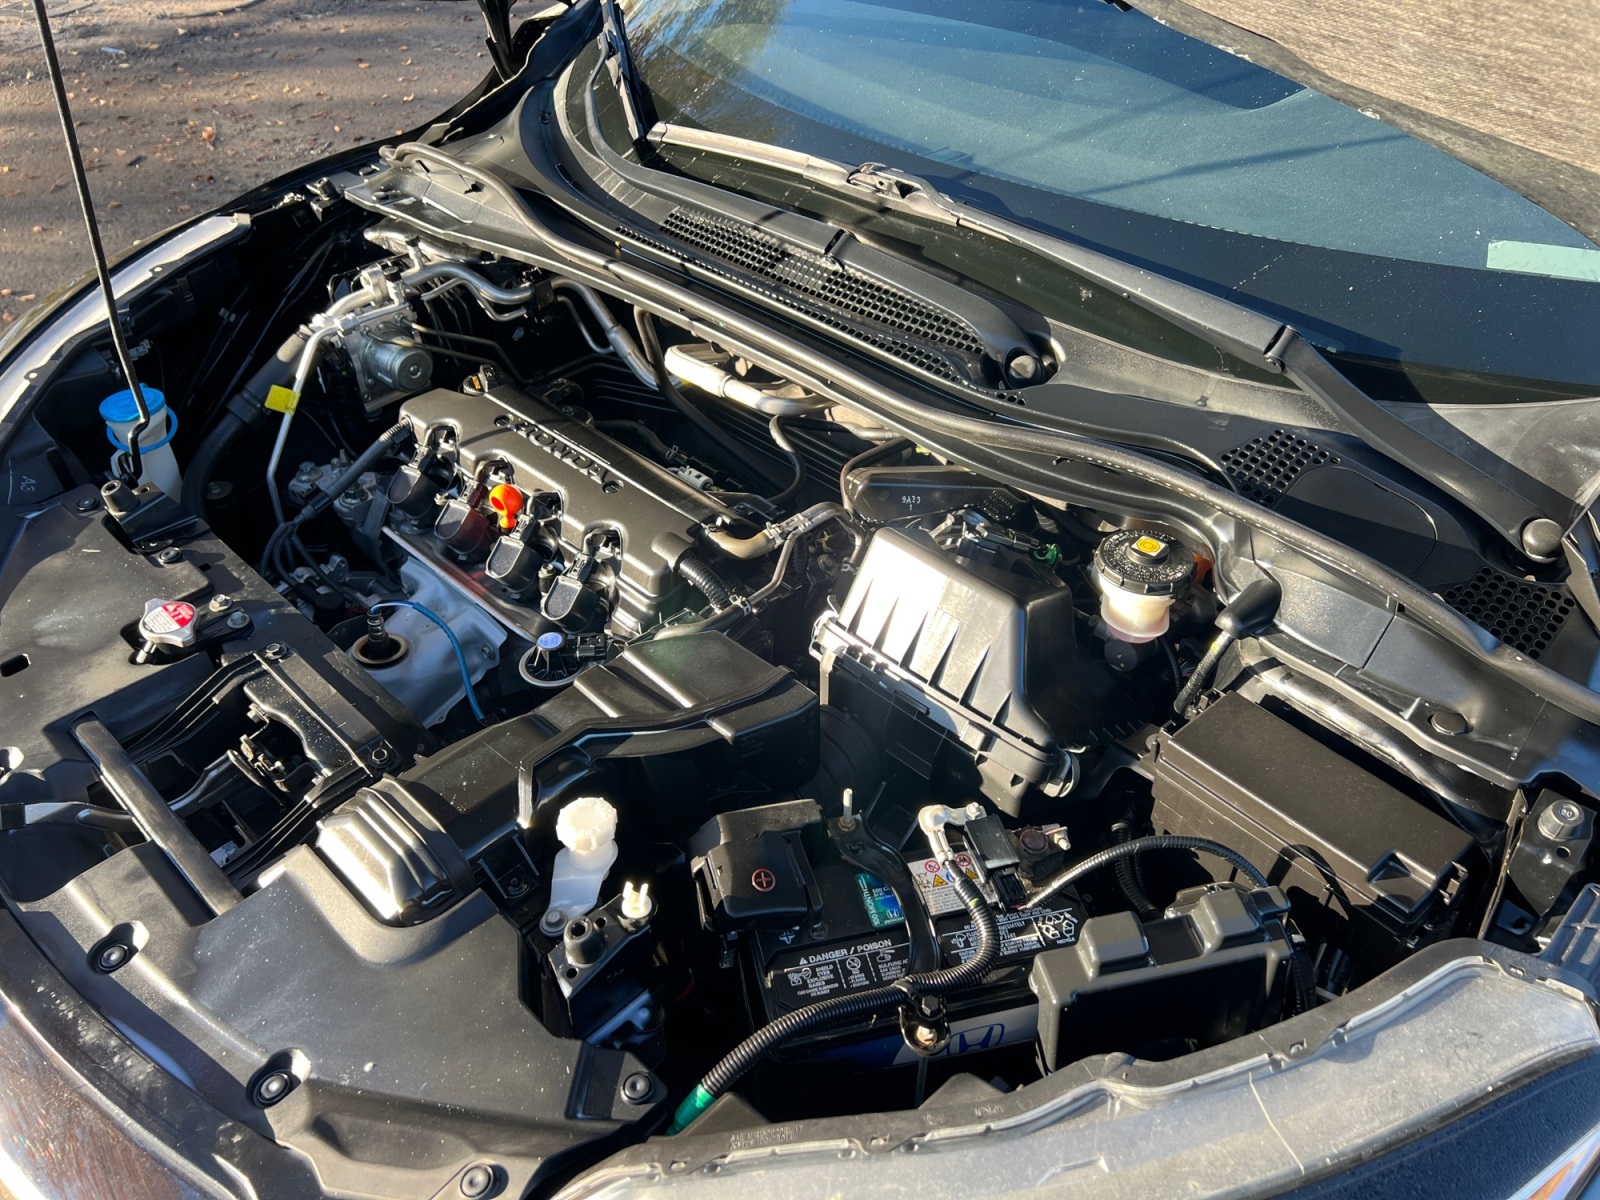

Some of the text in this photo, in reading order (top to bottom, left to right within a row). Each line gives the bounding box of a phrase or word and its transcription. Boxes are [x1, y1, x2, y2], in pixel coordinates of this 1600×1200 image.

[507, 417, 613, 485] HONDA
[862, 888, 877, 914] MONTH
[808, 948, 848, 963] DANGER
[857, 938, 892, 953] POISON
[806, 973, 834, 984] EXPLOSIVE
